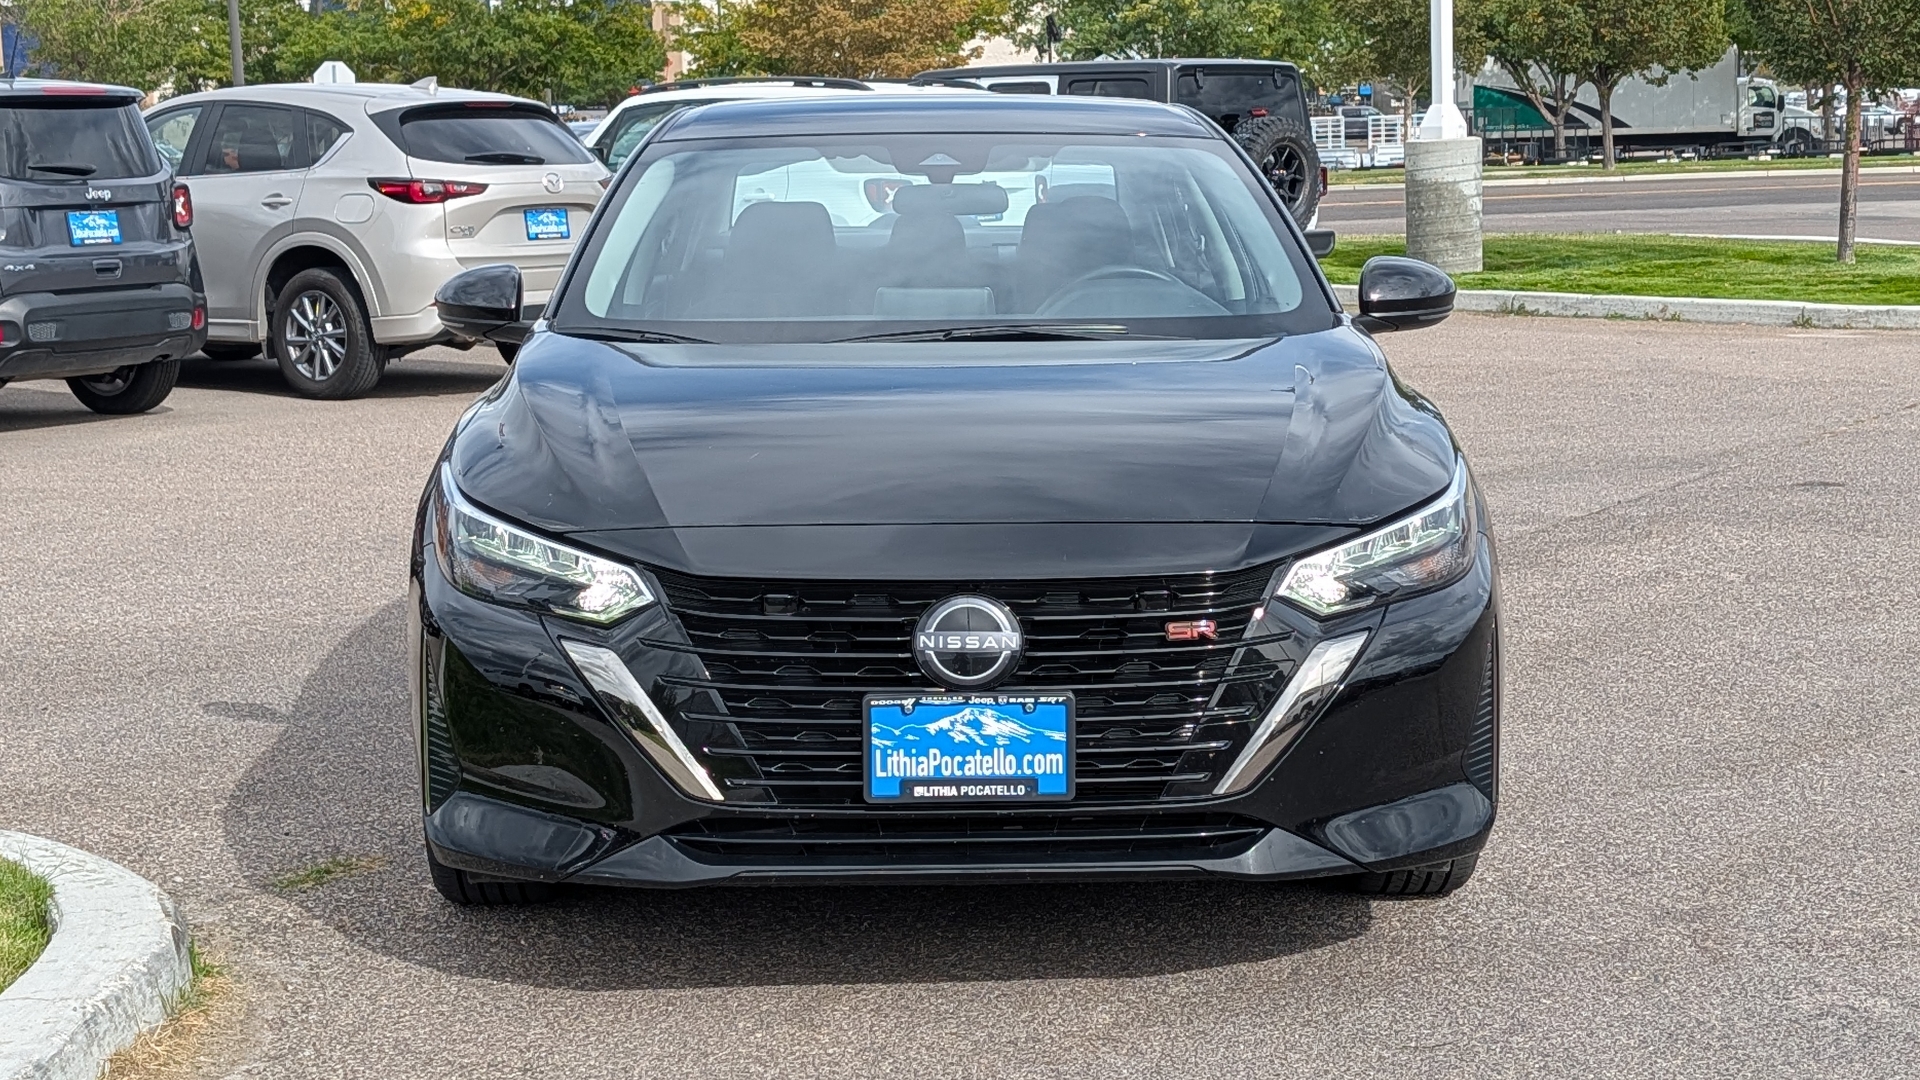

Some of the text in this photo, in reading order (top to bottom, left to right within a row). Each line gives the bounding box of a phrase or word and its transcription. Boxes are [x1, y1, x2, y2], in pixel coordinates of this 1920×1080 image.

[85, 187, 111, 201] Jeep
[1166, 620, 1217, 640] SR
[919, 635, 1017, 649] NISSAN
[875, 747, 1064, 778] LithiaPocatello.com
[924, 785, 1026, 797] LITHIA POCATELLO
